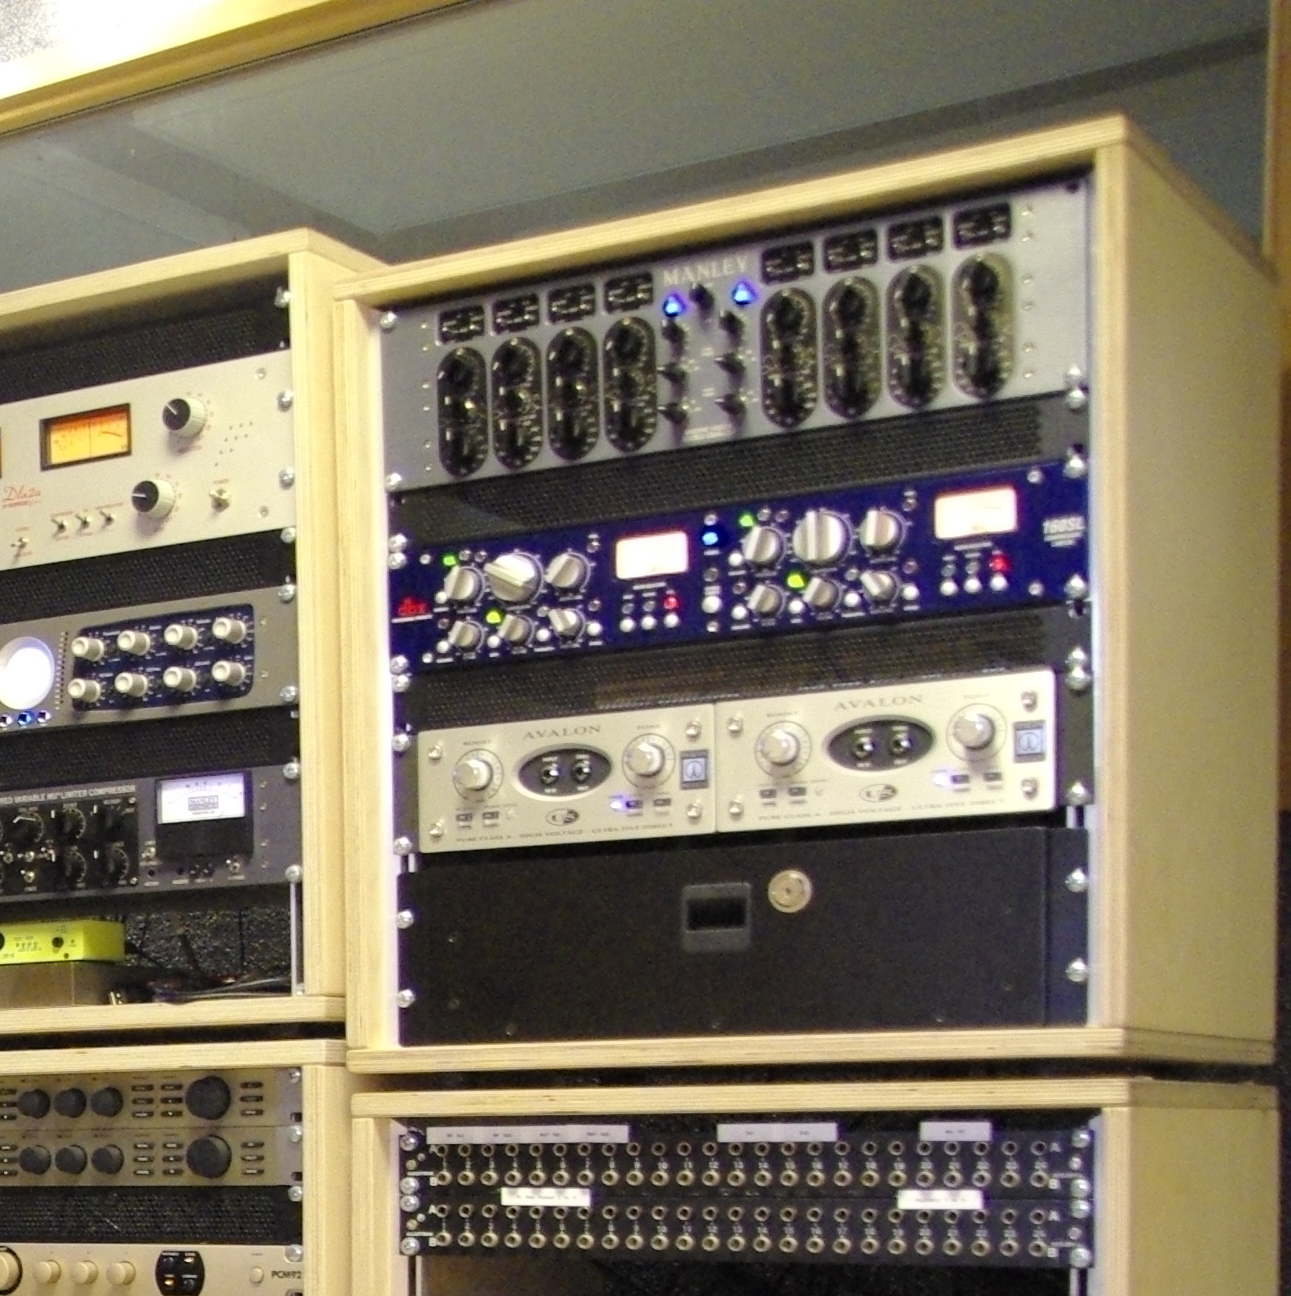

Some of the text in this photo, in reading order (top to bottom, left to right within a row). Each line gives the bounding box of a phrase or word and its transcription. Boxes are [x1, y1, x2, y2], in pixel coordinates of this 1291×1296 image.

[663, 255, 748, 286] MANLEY
[834, 694, 924, 711] AVALON
[522, 725, 602, 741] AVALON
[13, 793, 46, 804] VARIABLE
[88, 785, 136, 797] COMPRESSOR
[271, 1270, 302, 1279] PCM92
